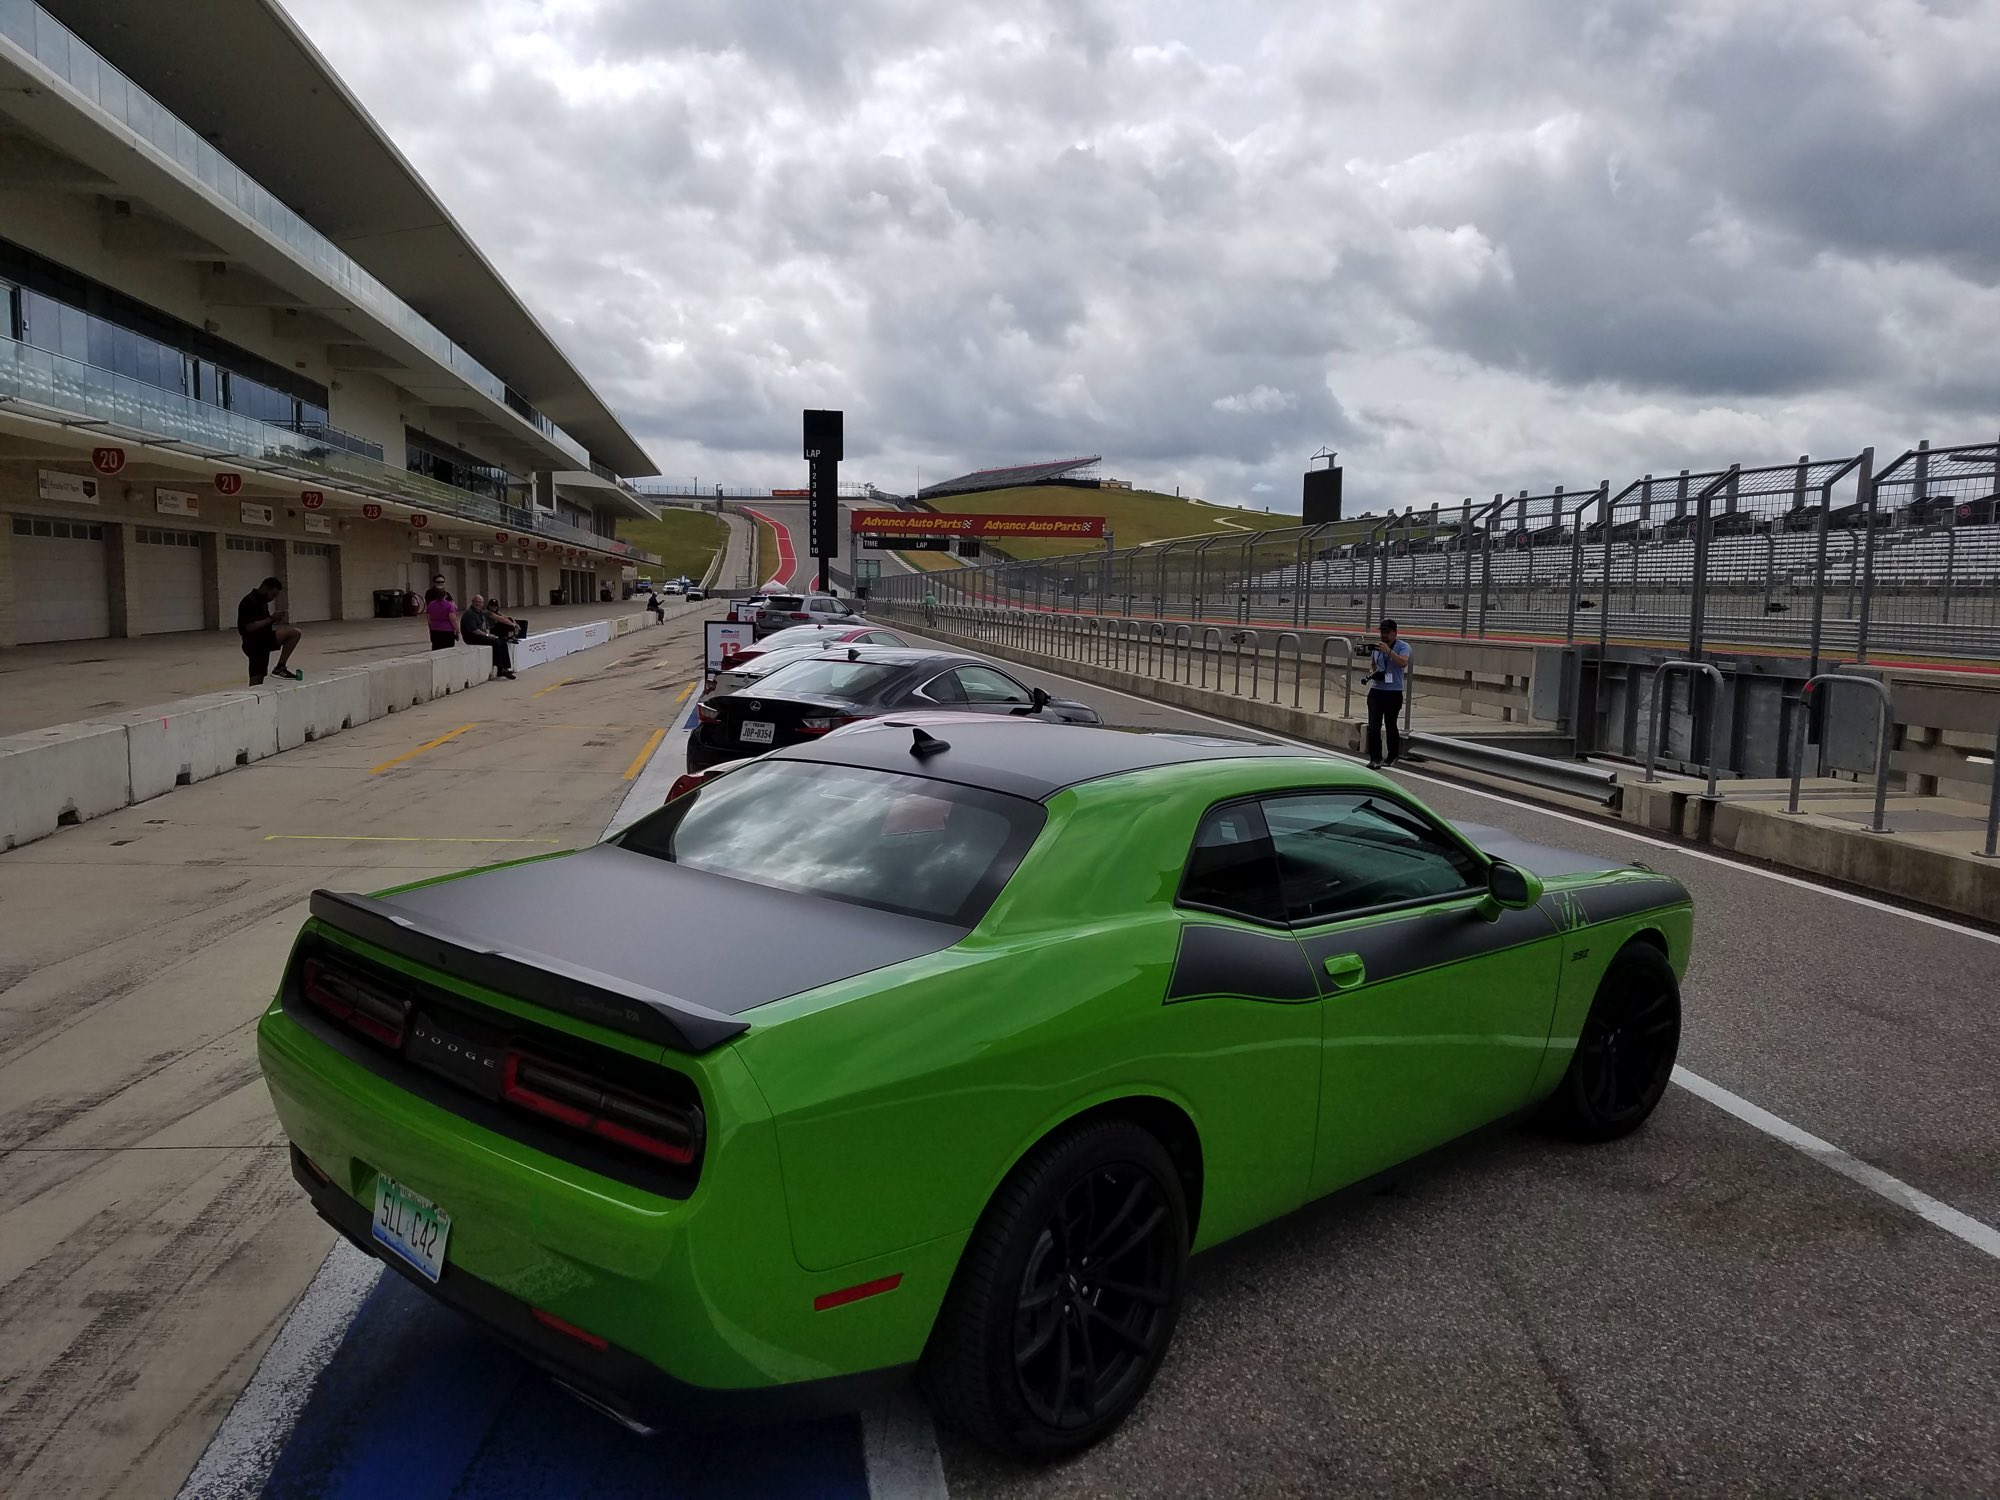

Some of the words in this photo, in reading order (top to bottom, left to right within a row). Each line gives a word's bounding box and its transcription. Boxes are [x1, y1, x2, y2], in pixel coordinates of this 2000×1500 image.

[100, 450, 118, 468] 20
[806, 450, 821, 458] LAP
[222, 475, 234, 490] 21
[306, 493, 319, 506] 22
[367, 505, 378, 517] 23
[862, 516, 906, 527] Advance
[907, 518, 934, 528] Auto
[934, 519, 962, 529] Parts
[984, 520, 1027, 530] Advance
[1027, 521, 1054, 531] Auto
[1054, 521, 1082, 532] Parts
[864, 540, 878, 548] TIME
[415, 1029, 495, 1068] DODGE
[381, 1191, 403, 1238] 5LL
[411, 1210, 439, 1259] C42
